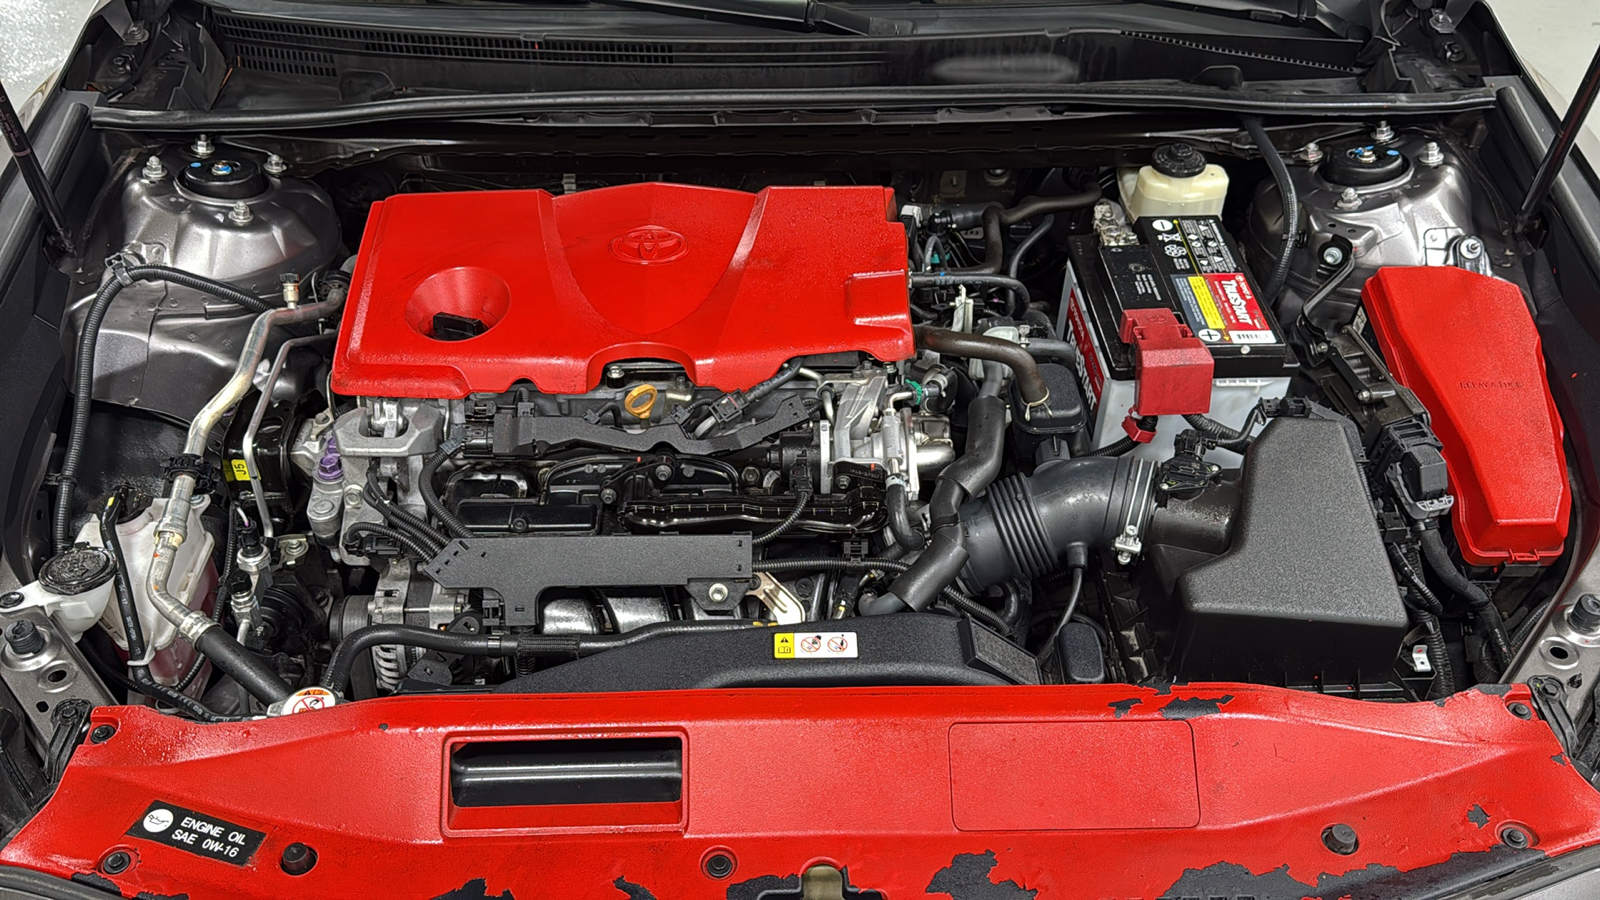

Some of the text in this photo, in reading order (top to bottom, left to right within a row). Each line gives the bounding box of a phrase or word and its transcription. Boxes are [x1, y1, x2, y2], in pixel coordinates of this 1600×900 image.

[1239, 280, 1253, 300] TOYOTA
[1071, 305, 1085, 342] TOYOTA
[233, 463, 247, 476] J5
[171, 829, 239, 858] SAE 0W-16
[180, 816, 246, 846] ENGINE OIL
